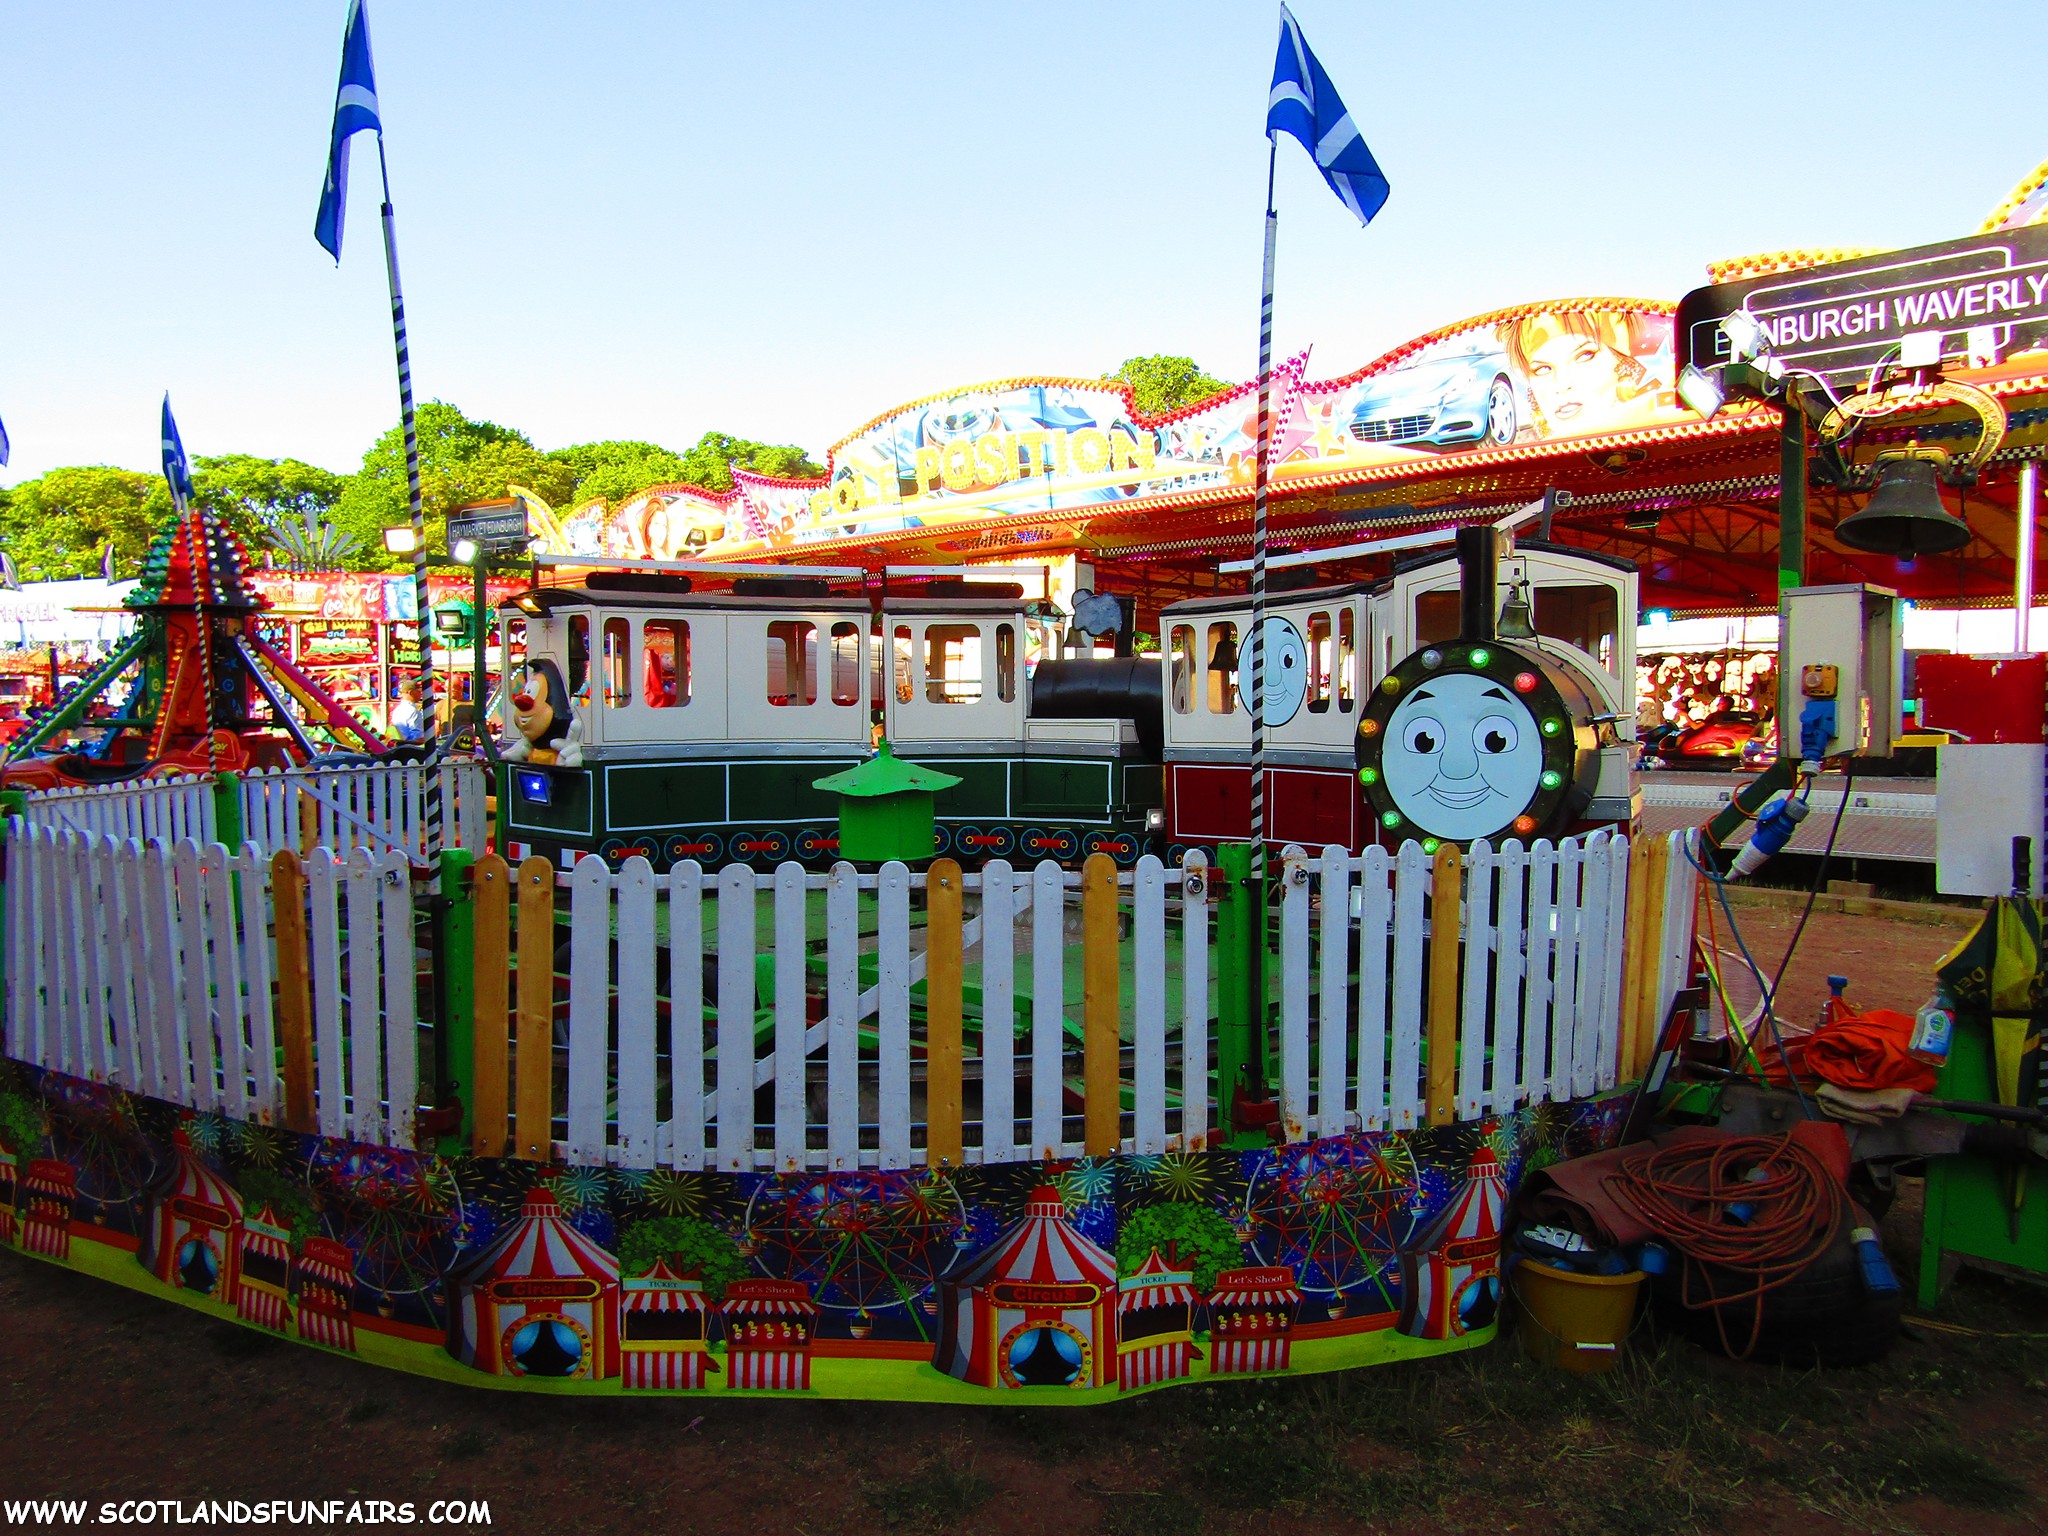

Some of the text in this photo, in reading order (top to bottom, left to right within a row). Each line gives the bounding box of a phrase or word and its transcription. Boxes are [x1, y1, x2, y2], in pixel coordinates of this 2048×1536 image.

[1714, 272, 2048, 356] ENBURGH WAVERLY
[809, 427, 1156, 523] POLE POSITION
[451, 518, 522, 538] HAYMARKET EDINBURGH
[327, 629, 346, 638] and
[394, 649, 421, 664] HOR
[1140, 1275, 1168, 1285] TICKET
[1228, 1274, 1283, 1284] Let's Shoot
[648, 1280, 678, 1289] TICKET
[738, 1284, 795, 1294] Let's Shoot
